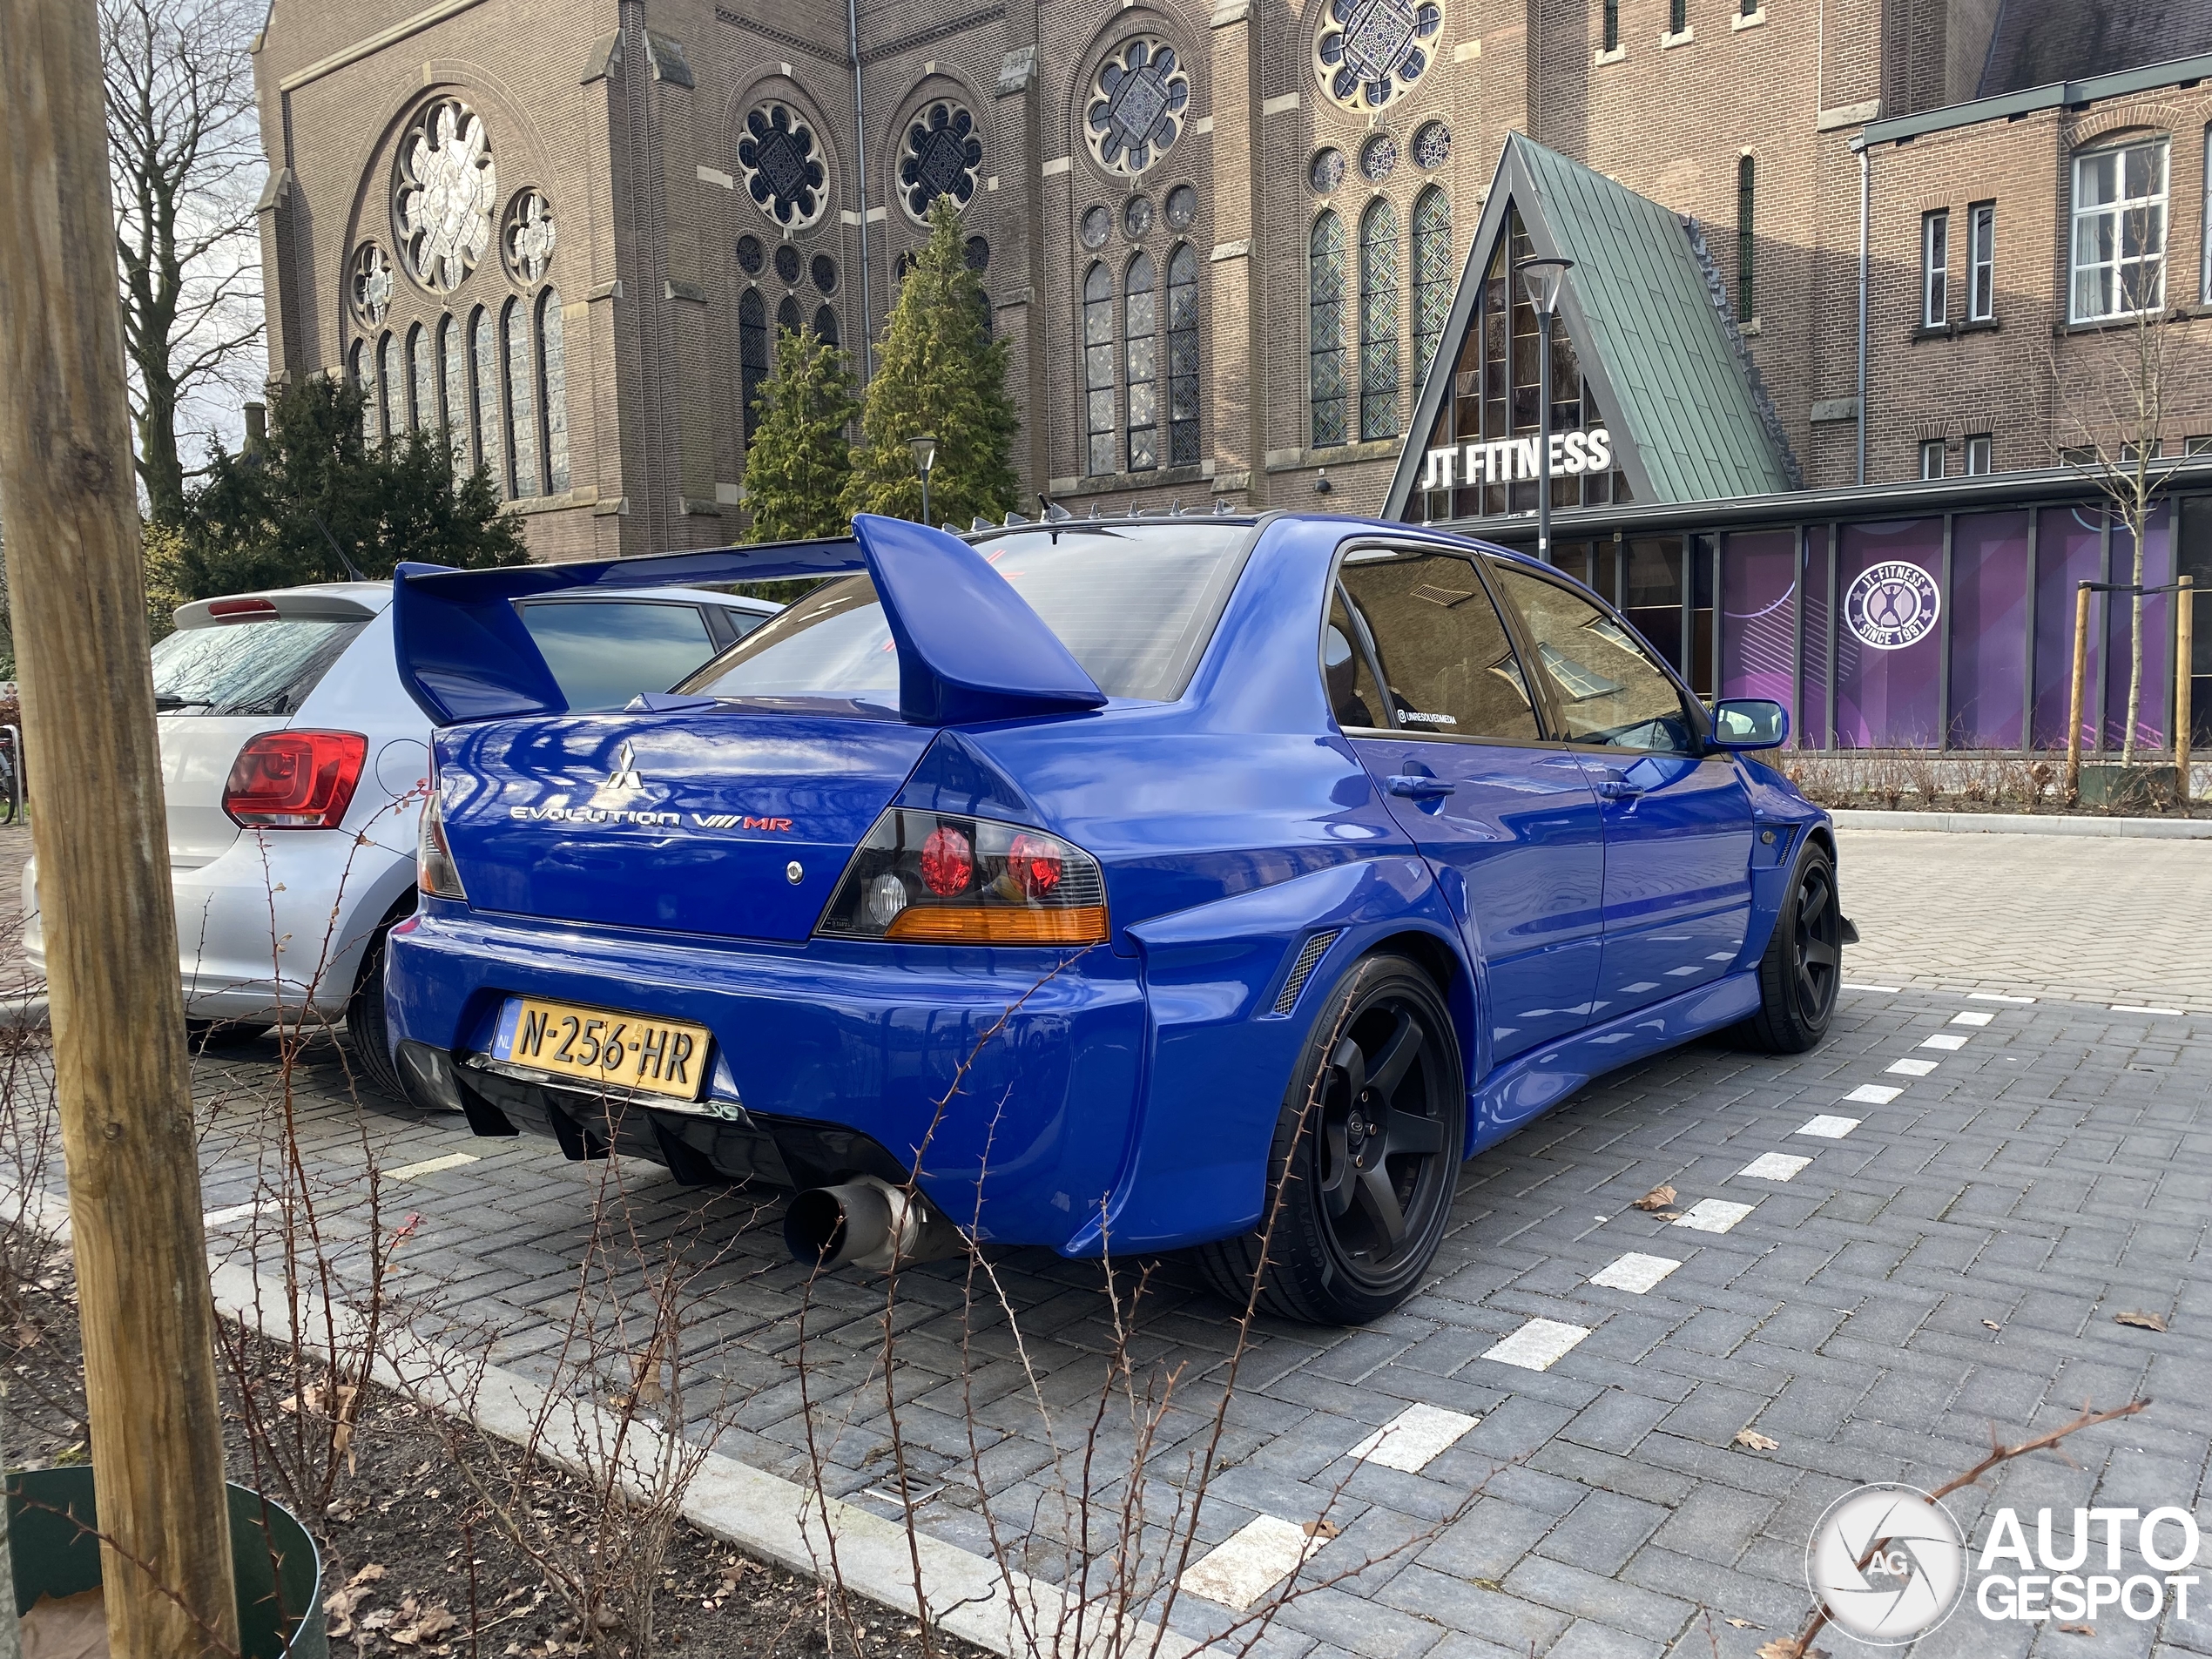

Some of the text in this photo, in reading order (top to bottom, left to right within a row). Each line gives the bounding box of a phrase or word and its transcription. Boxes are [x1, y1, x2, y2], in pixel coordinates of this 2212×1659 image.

[1422, 428, 1611, 489] JT FITNESS
[1862, 566, 1925, 589] JT-FITNESS
[1859, 621, 1925, 644] SINCE 1997
[1406, 711, 1457, 724] UNRESOLVEDMEDIA
[509, 806, 681, 826] EVOLUTION
[743, 816, 792, 832] MR
[497, 1034, 510, 1049] NL
[518, 1009, 693, 1084] N-256-HR
